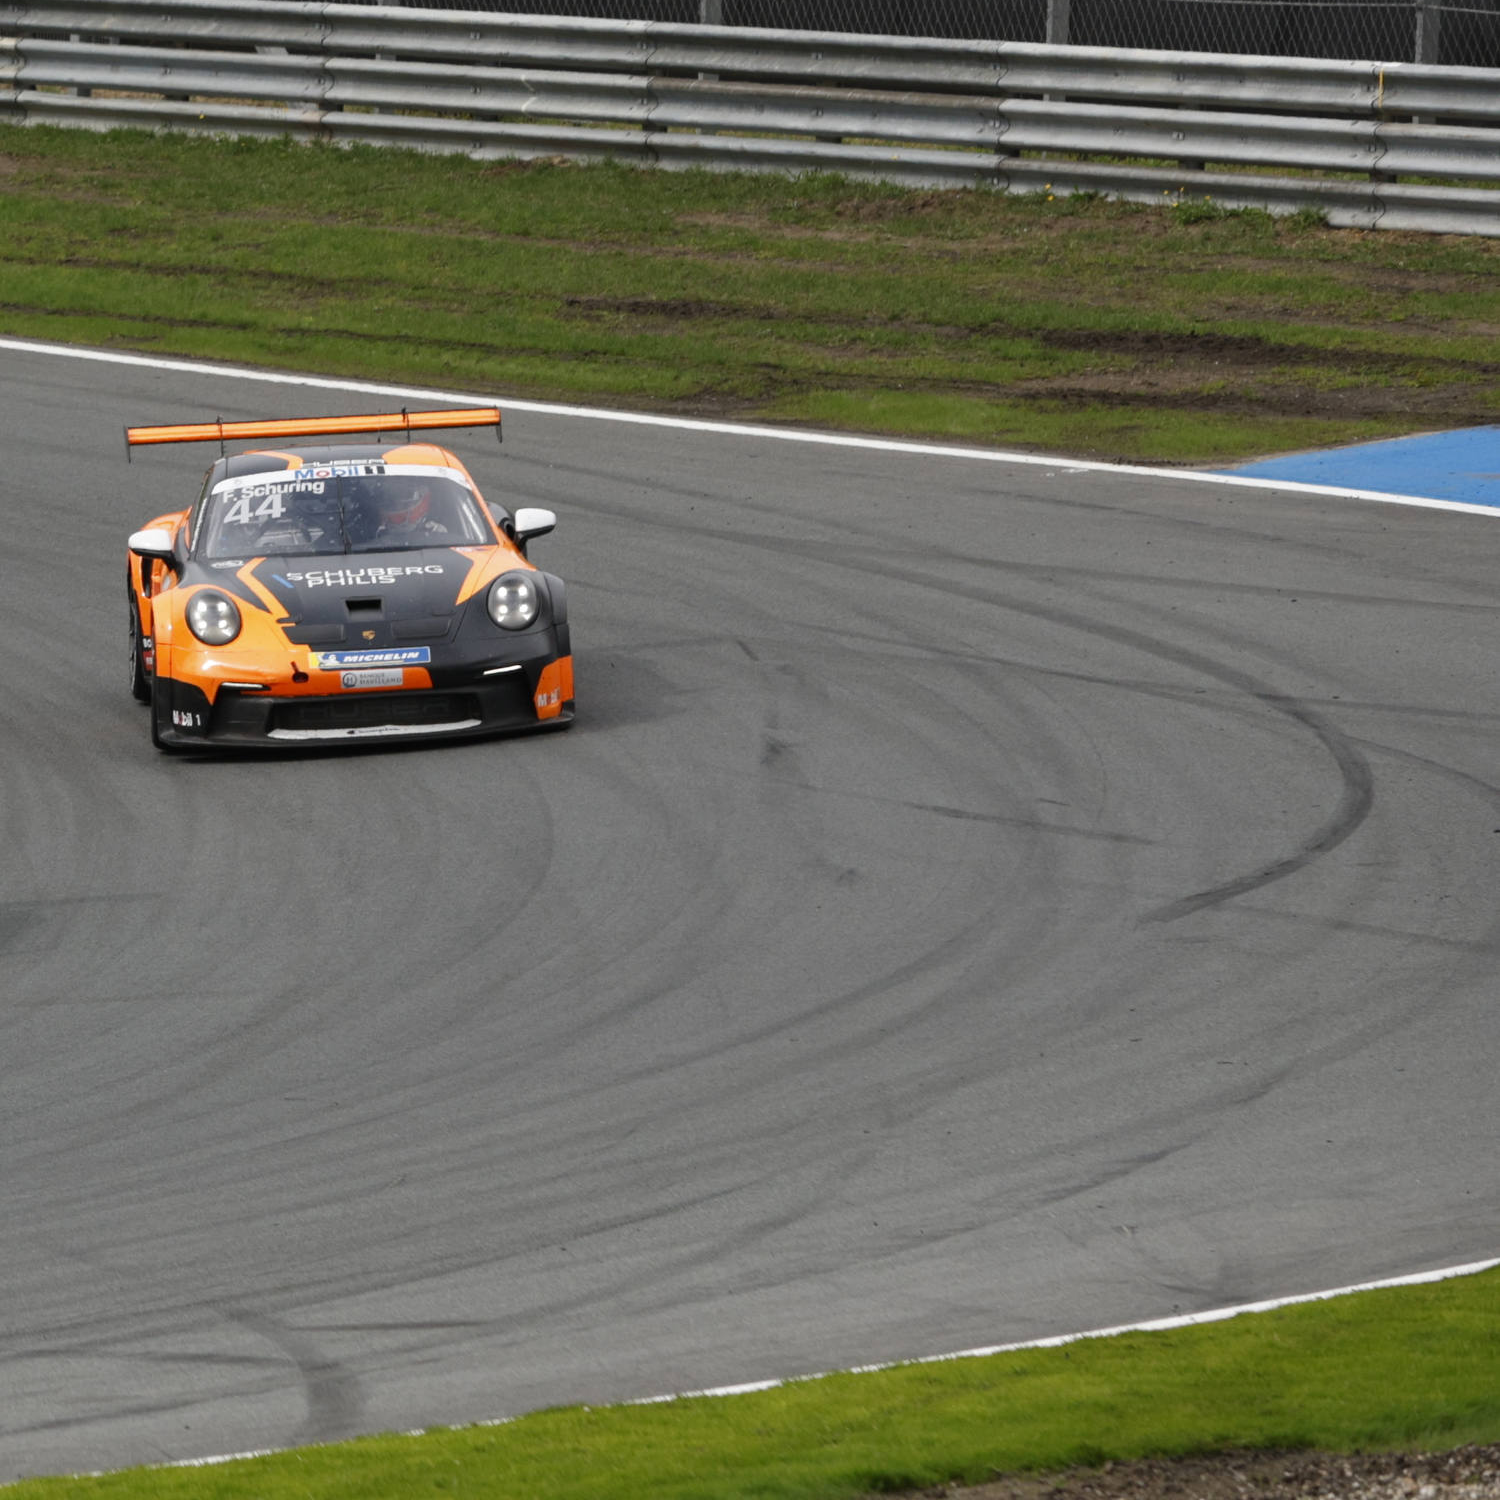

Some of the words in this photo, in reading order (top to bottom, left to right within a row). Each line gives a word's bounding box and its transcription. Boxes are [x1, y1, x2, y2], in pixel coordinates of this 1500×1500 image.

[295, 467, 359, 480] Mobil
[223, 490, 238, 504] F.
[241, 480, 325, 498] Schuring
[222, 493, 287, 525] 44
[286, 564, 445, 581] SCHUBERG
[307, 574, 396, 588] PHILIS
[343, 650, 421, 663] MICHELIN
